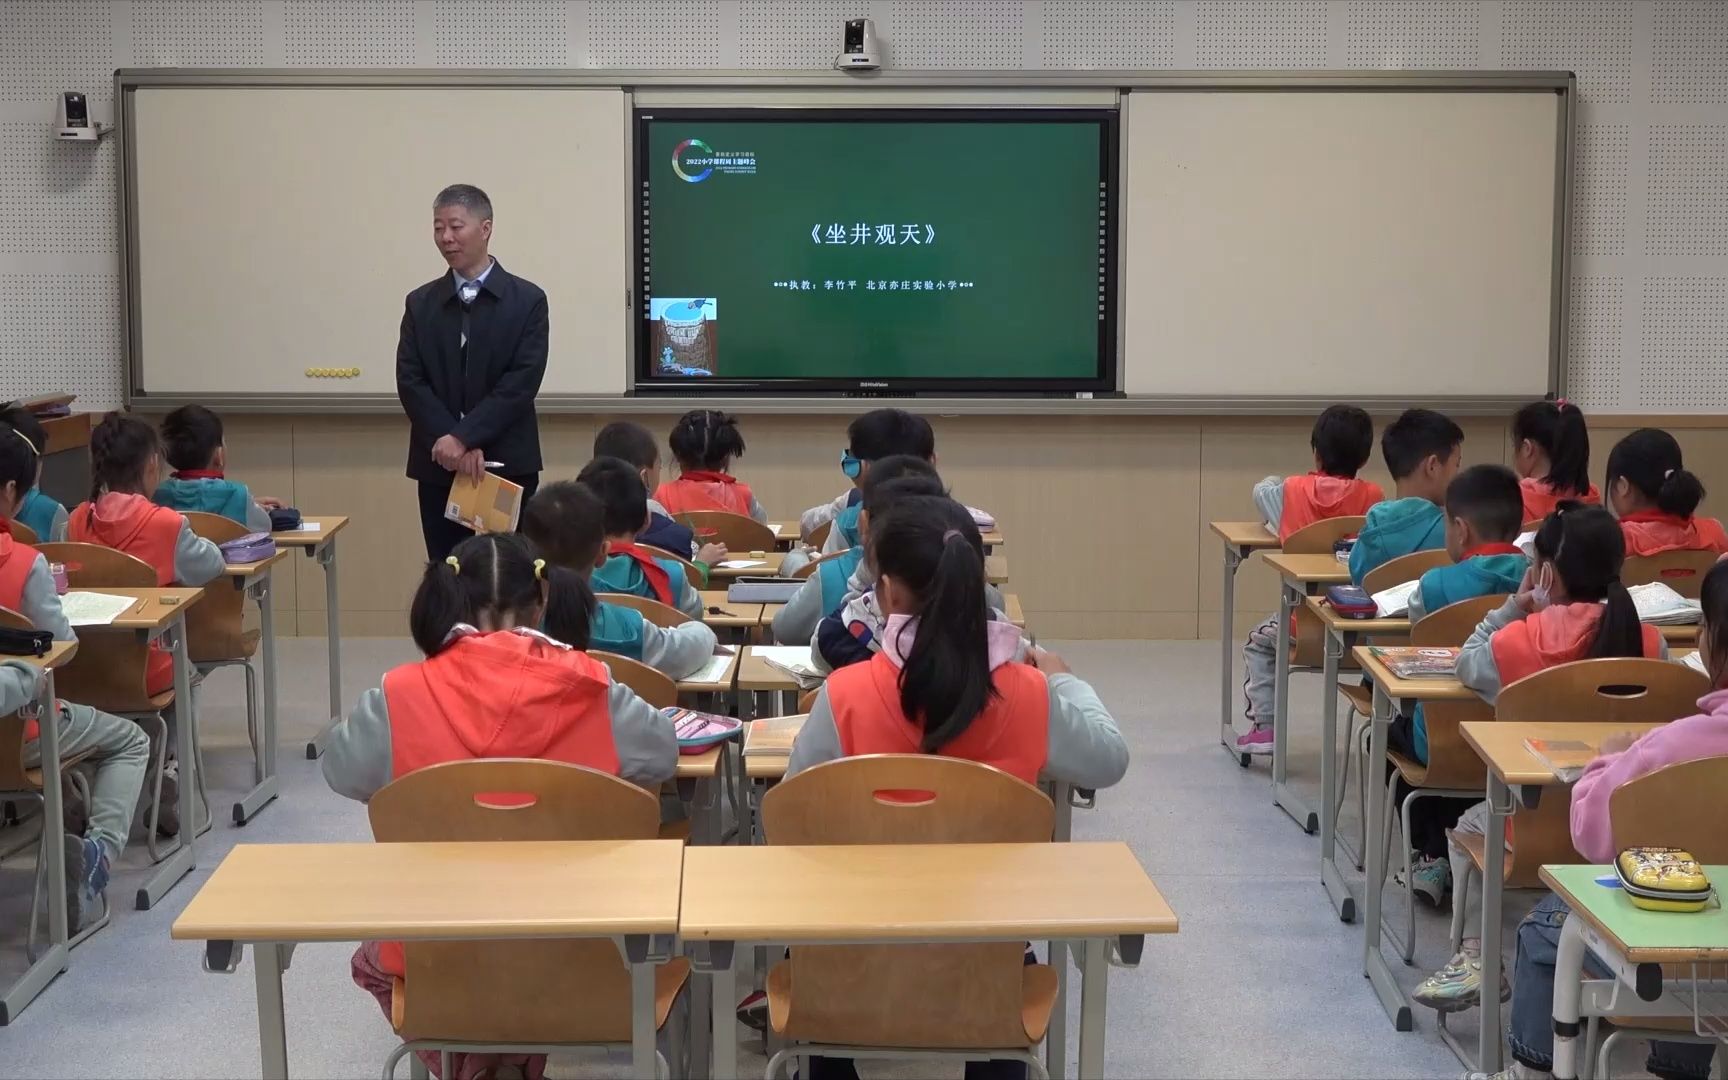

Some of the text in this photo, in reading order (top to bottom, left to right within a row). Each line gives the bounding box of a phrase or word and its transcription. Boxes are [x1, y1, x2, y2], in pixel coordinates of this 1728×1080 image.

[811, 222, 936, 246] 《坐井观天》
[866, 279, 958, 291] 北京亦庄实验小学
